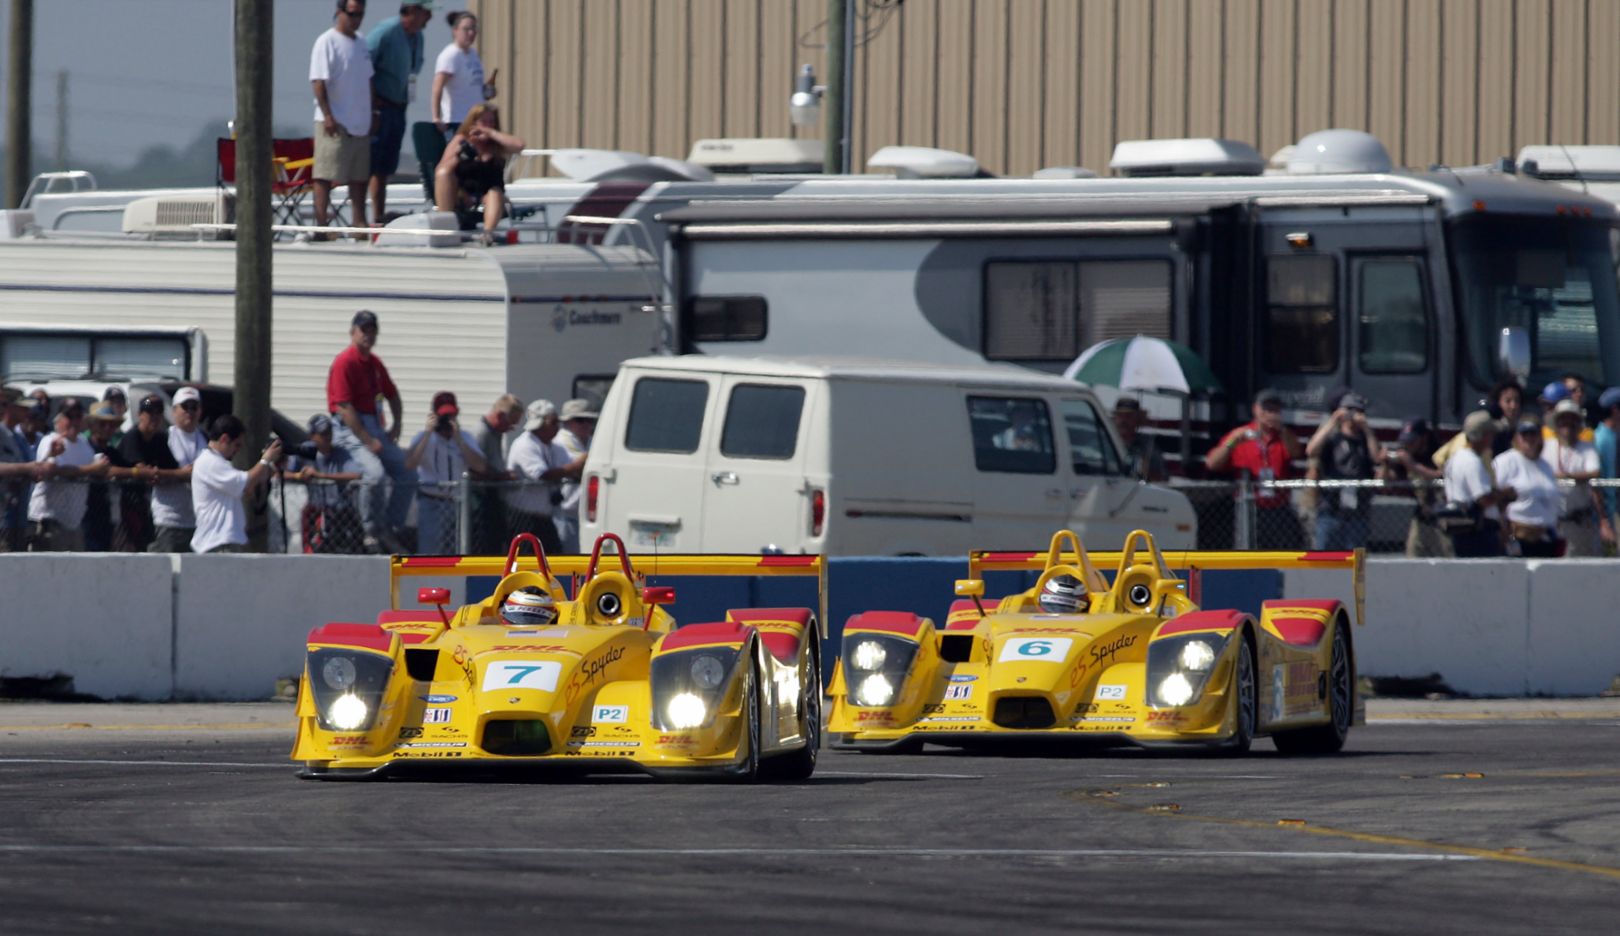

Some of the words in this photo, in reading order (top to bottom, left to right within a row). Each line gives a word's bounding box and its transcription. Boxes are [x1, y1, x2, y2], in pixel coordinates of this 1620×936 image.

[1017, 640, 1053, 656] 6
[1088, 634, 1138, 669] Spyder
[581, 645, 626, 688] Spyder
[503, 665, 542, 684] 7
[1099, 687, 1123, 697] P2
[598, 708, 622, 720] P2
[856, 711, 895, 720] DHL
[1147, 711, 1188, 720] DHL
[332, 735, 371, 745] DHL
[656, 735, 696, 744] DHL
